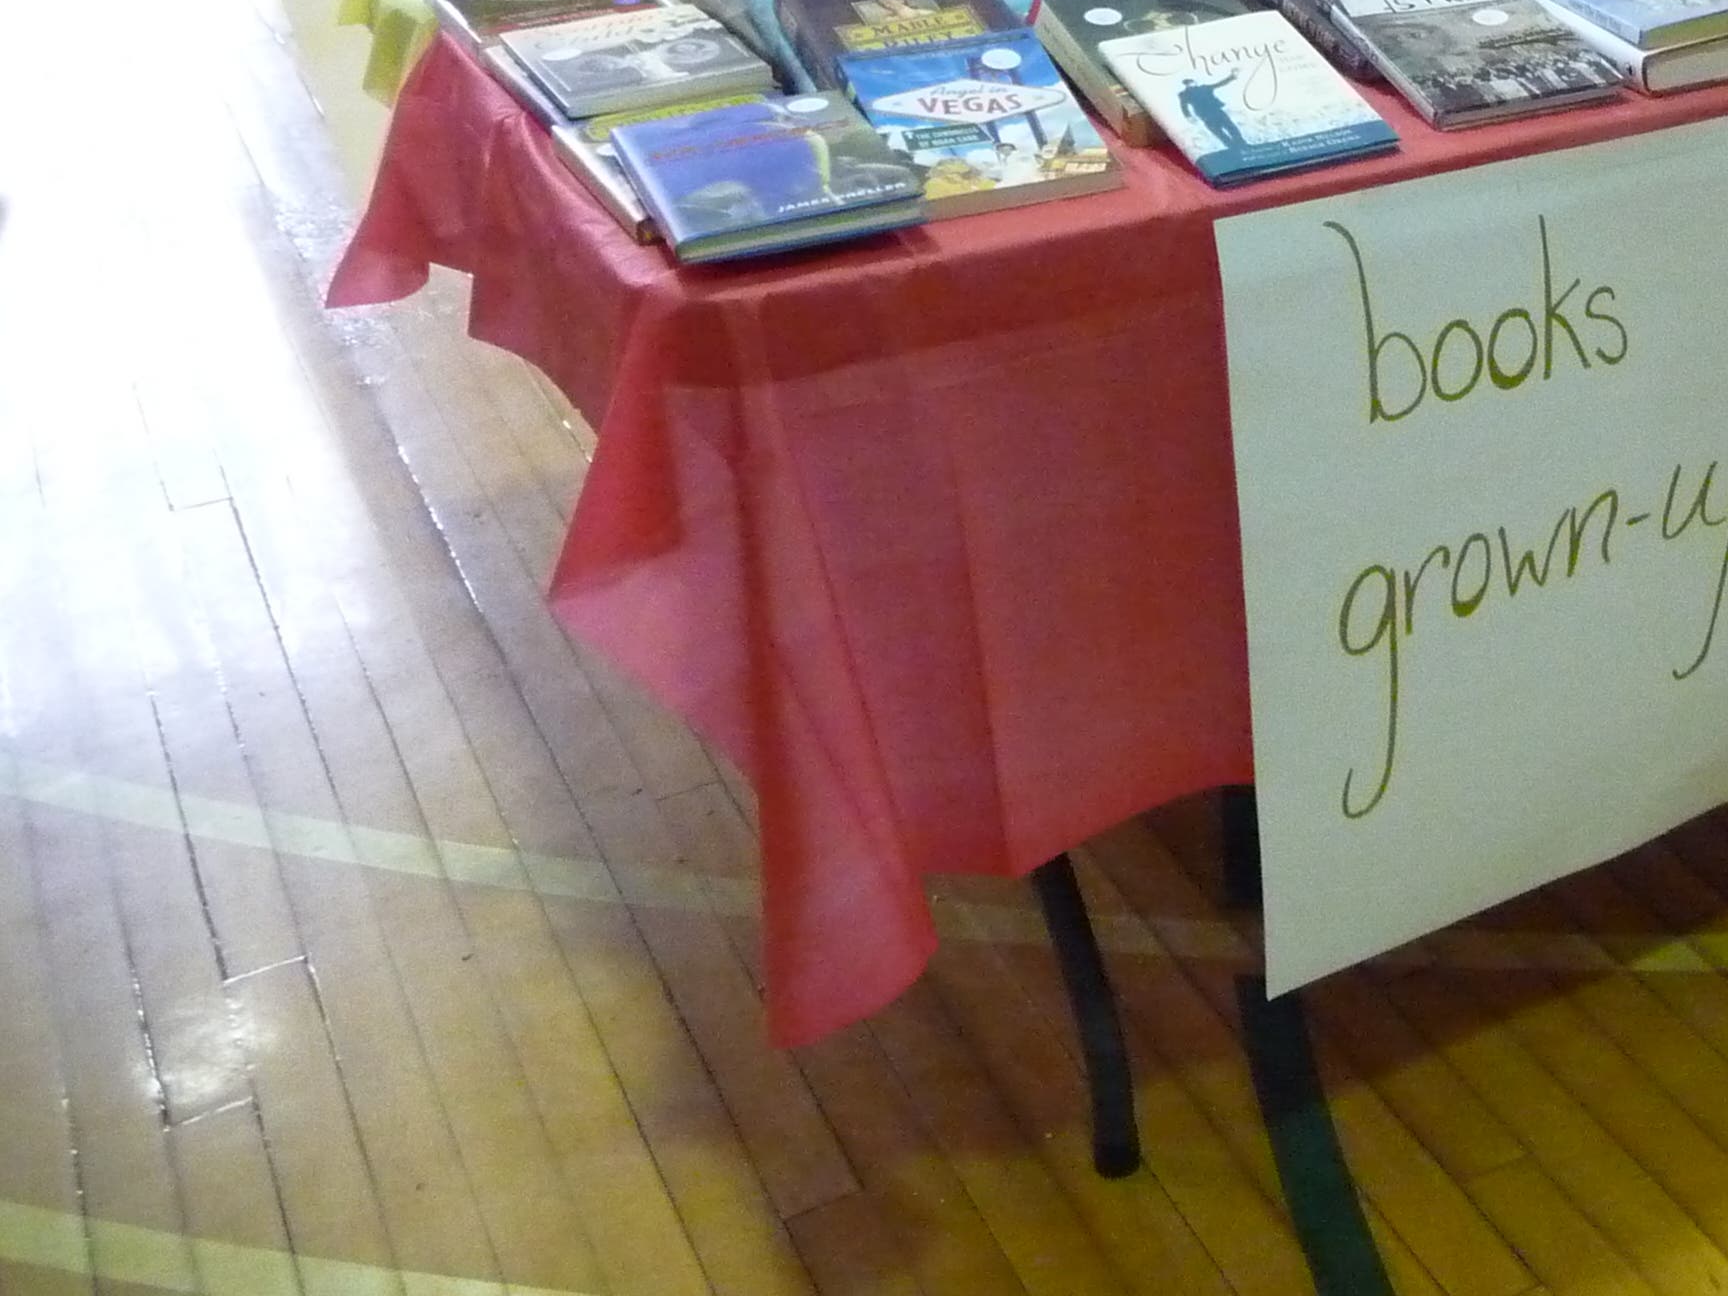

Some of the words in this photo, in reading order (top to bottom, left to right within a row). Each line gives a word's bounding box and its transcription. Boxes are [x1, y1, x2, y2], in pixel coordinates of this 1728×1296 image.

[917, 93, 1022, 116] VEGAS
[1120, 24, 1287, 111] Change
[1324, 213, 1629, 426] books
